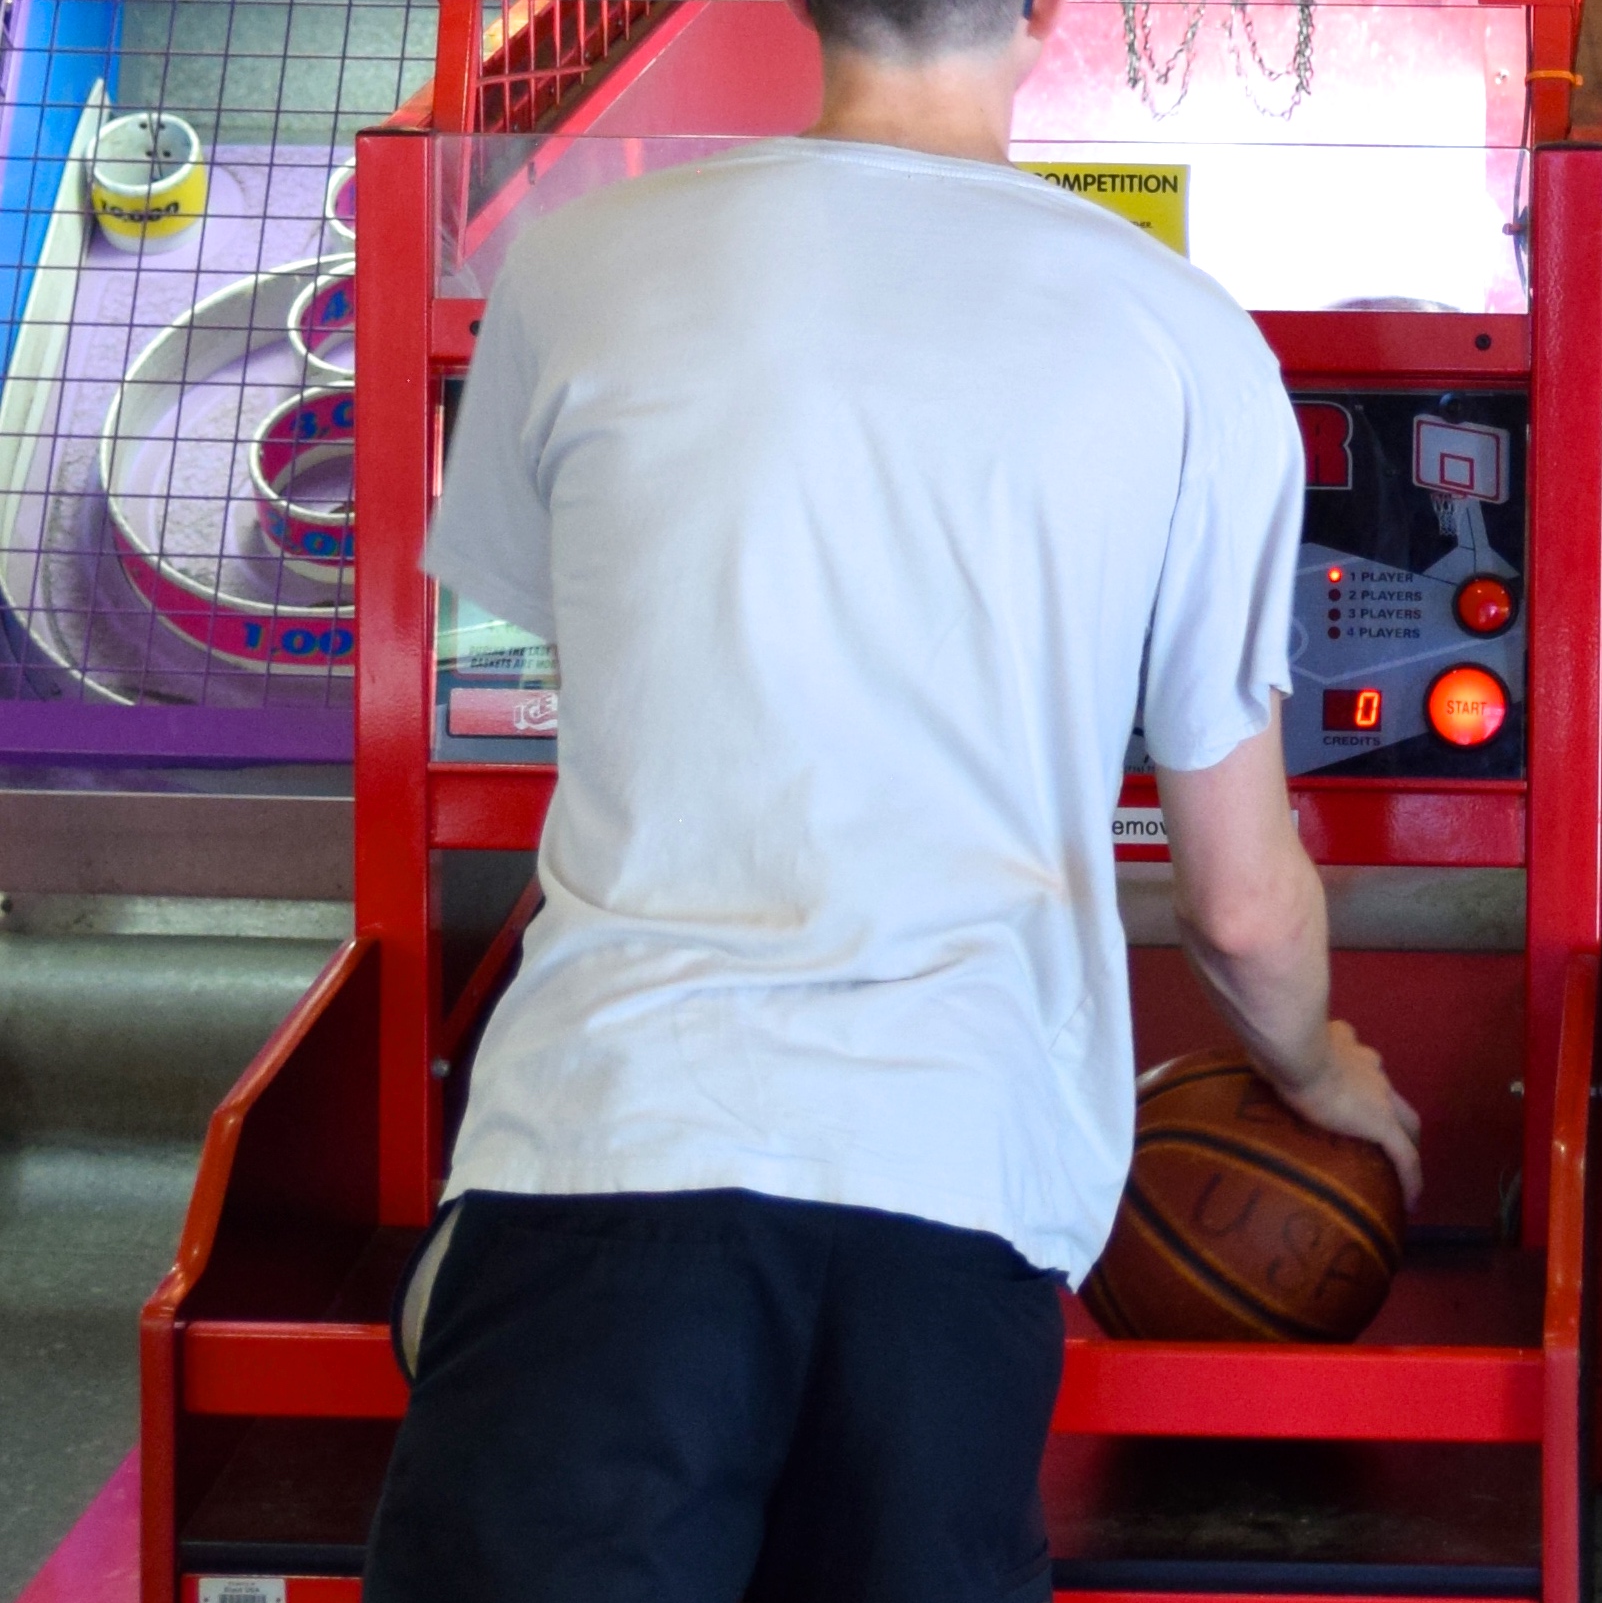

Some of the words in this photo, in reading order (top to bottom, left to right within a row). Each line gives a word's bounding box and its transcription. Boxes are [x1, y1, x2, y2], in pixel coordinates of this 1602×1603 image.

[1033, 172, 1178, 193] OMPETITION
[1361, 572, 1413, 583] PLAYER
[1349, 591, 1357, 601] 2
[1362, 591, 1423, 602] PLAYERS
[1349, 609, 1356, 619] 3
[1361, 609, 1421, 620] PLAYERS
[1359, 628, 1420, 639] PLAYERS
[1356, 691, 1380, 726] 0
[1446, 700, 1487, 715] START
[1322, 736, 1381, 746] CREDITS
